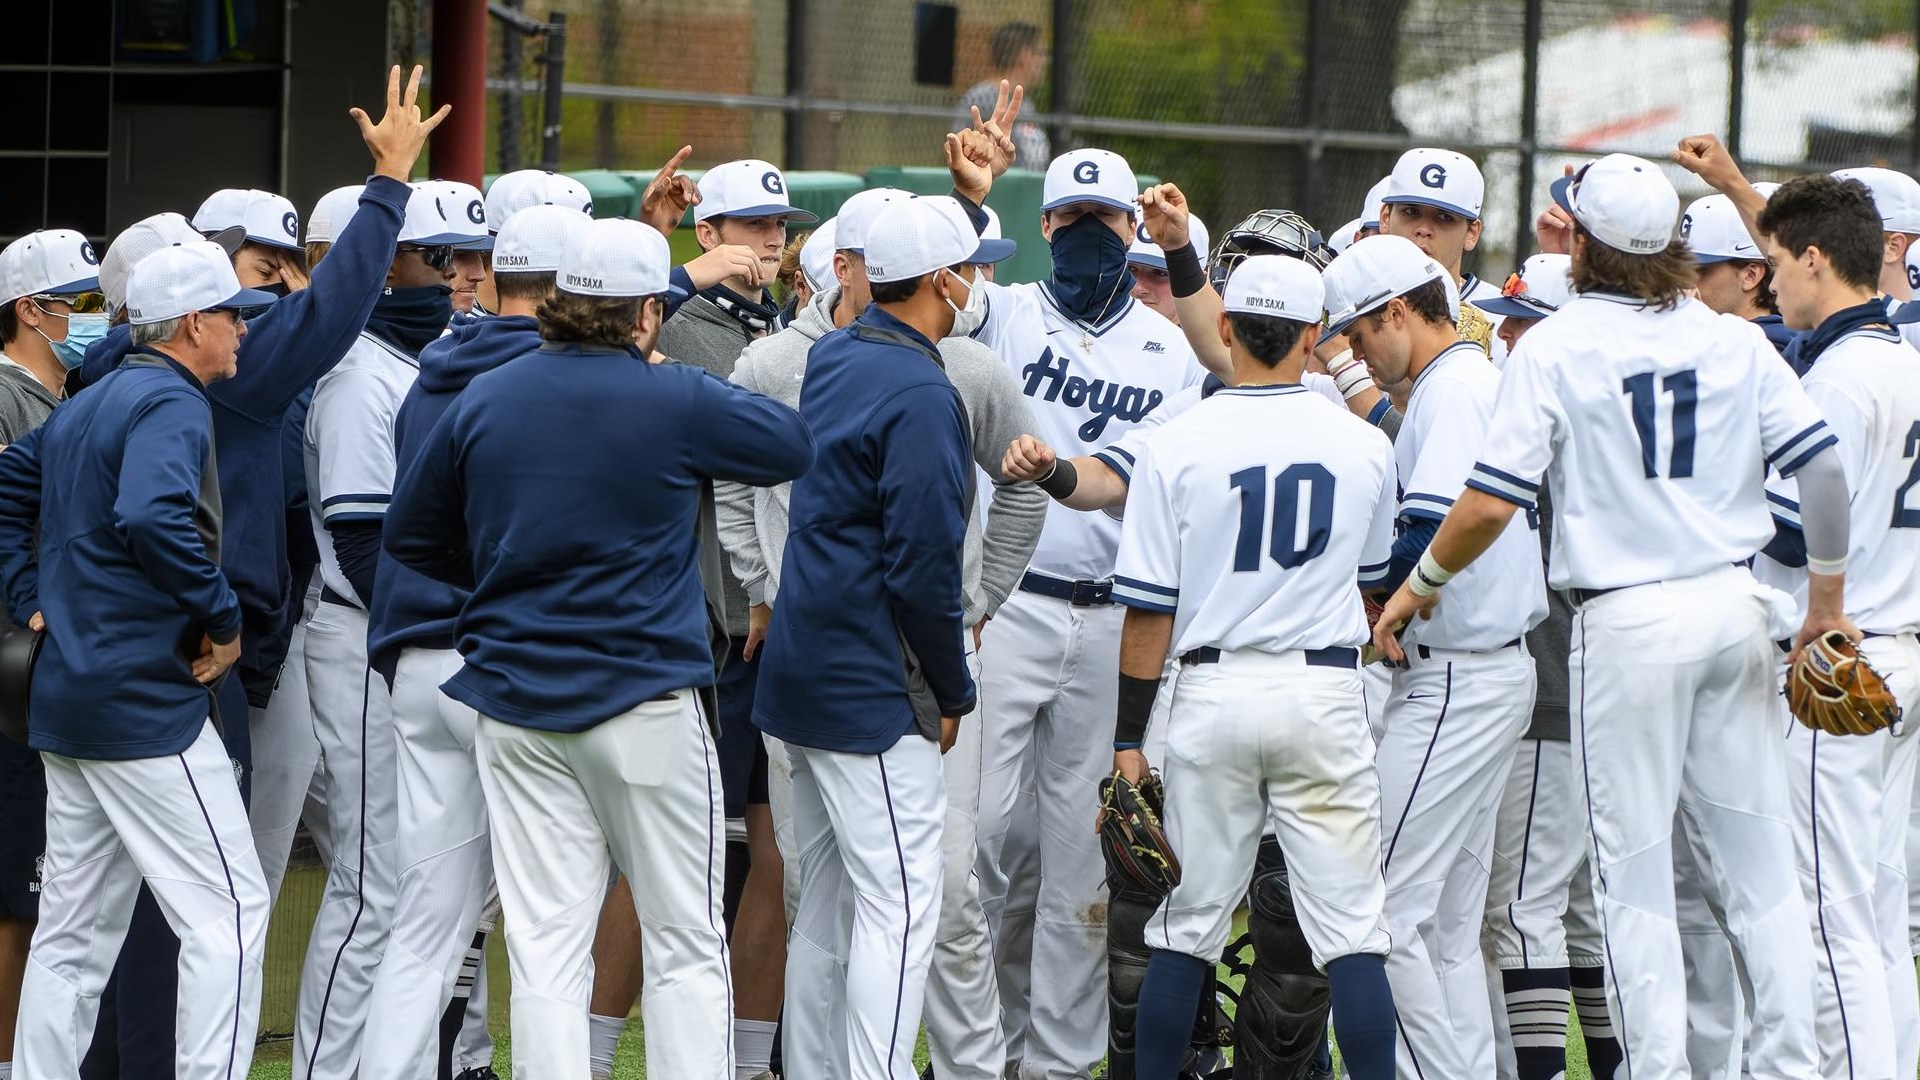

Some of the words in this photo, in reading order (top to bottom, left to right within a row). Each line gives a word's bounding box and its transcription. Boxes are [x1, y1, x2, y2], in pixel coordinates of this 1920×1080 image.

[761, 171, 784, 195] G
[1073, 161, 1100, 185] G
[1419, 163, 1448, 189] G
[466, 199, 486, 225] G
[282, 211, 298, 240] G
[80, 241, 99, 266] G
[509, 255, 529, 266] SAXA
[581, 277, 603, 289] SAXA
[1245, 296, 1264, 308] HOYA
[1264, 298, 1286, 311] SAXA
[1622, 368, 1698, 480] 11
[1229, 462, 1336, 573] 10
